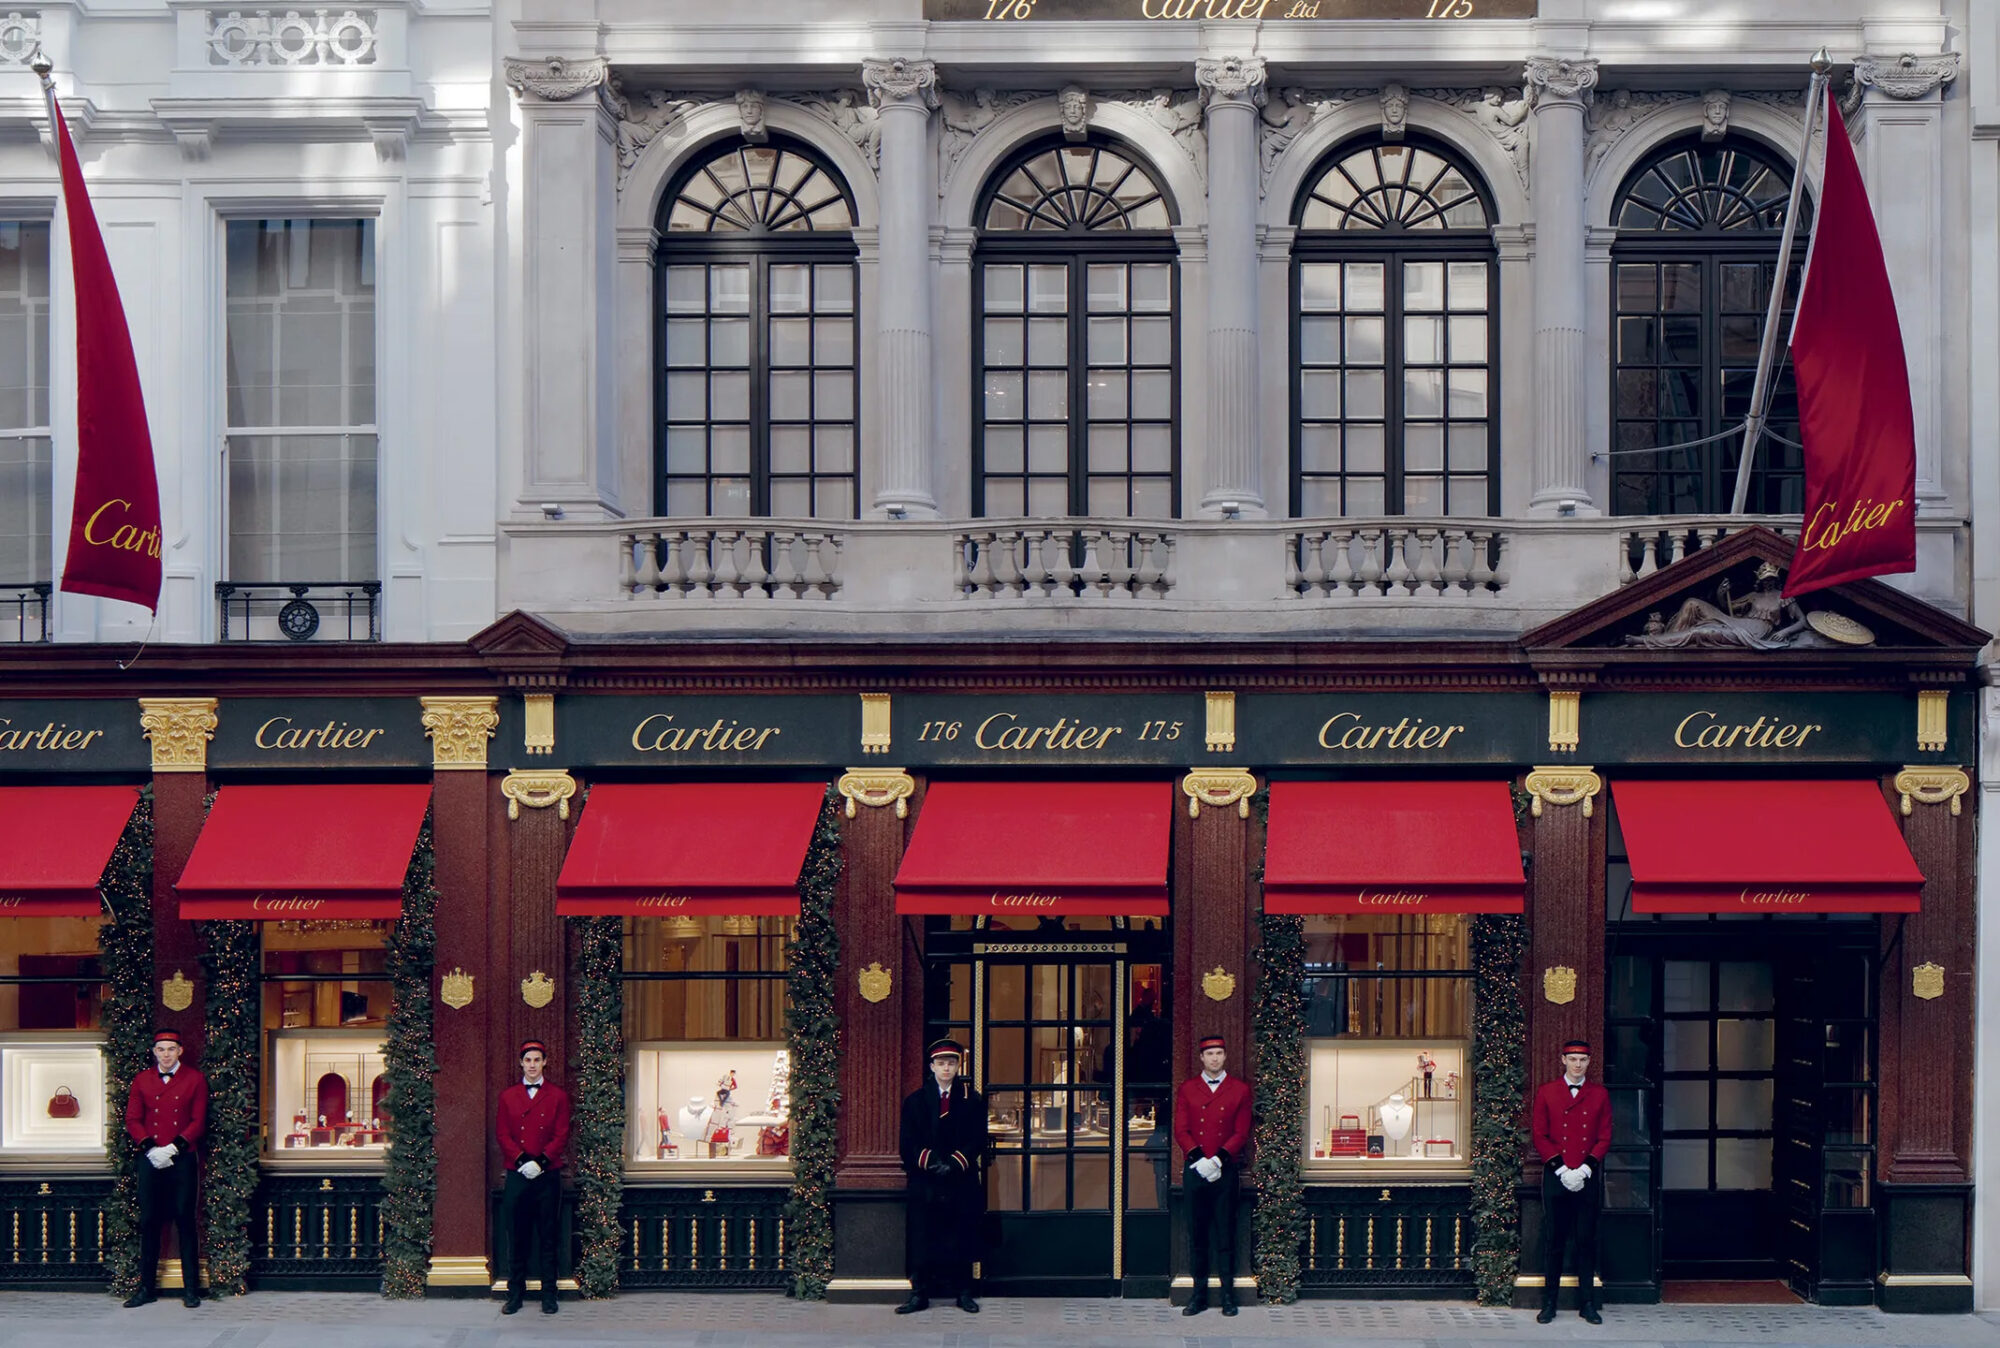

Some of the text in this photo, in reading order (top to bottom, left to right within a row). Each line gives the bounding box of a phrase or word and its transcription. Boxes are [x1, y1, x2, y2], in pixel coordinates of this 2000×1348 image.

[983, 0, 1474, 20] 176 Cartier Ltd 175
[84, 498, 162, 561] Carti
[255, 716, 385, 749] Cartier
[631, 713, 781, 751] Cartier
[919, 712, 1182, 750] 176 Cartier 175
[1318, 712, 1465, 750] Cartier
[1674, 710, 1822, 748] Cartier
[252, 893, 326, 911] Cartier
[635, 892, 692, 907] artier
[990, 889, 1062, 907] Cartier
[1357, 888, 1429, 905] Cartier
[1740, 887, 1810, 904] Cartier
